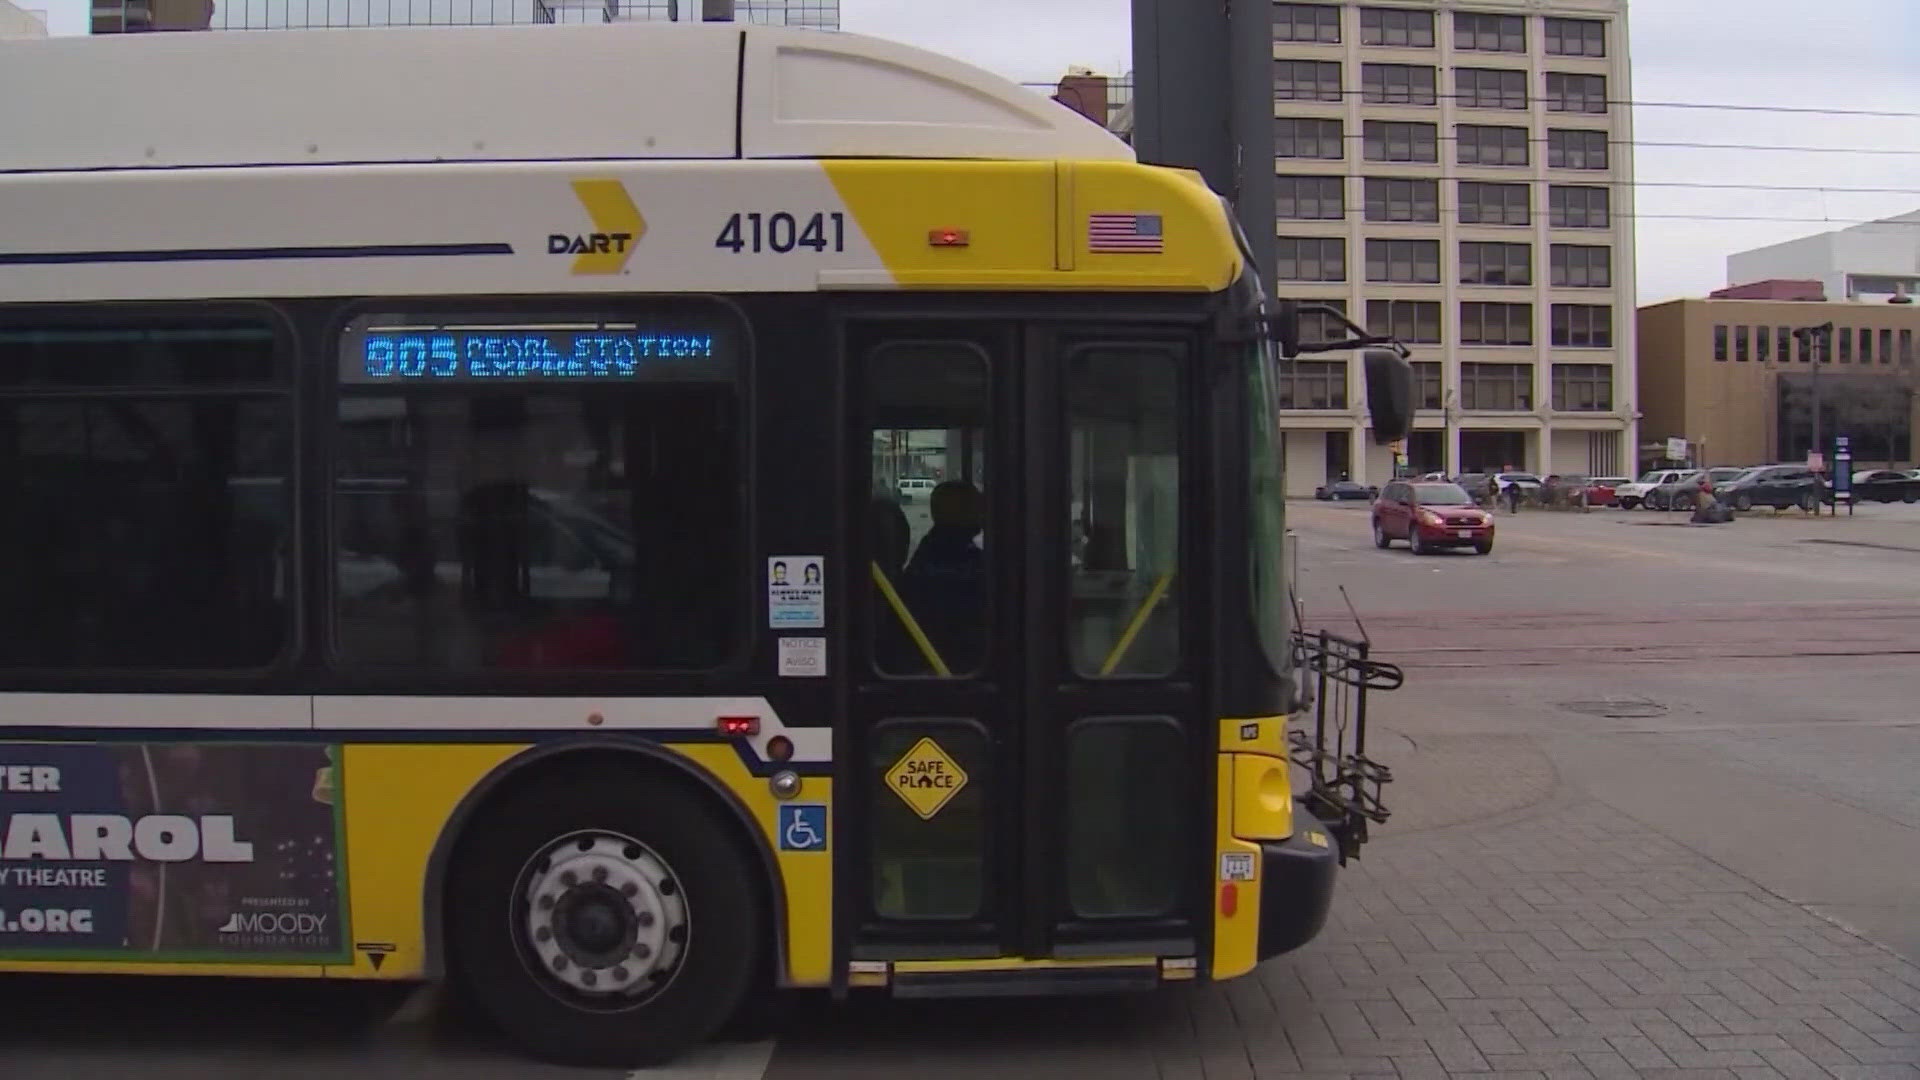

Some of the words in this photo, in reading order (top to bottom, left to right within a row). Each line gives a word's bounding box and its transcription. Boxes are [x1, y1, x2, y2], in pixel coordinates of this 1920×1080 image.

[715, 211, 844, 254] 41041
[548, 233, 632, 254] DART
[575, 334, 712, 357] STATION
[782, 639, 818, 648] NOTICE
[907, 761, 944, 774] SAFE
[13, 868, 107, 887] THEATRE
[237, 912, 327, 934] MOODY
